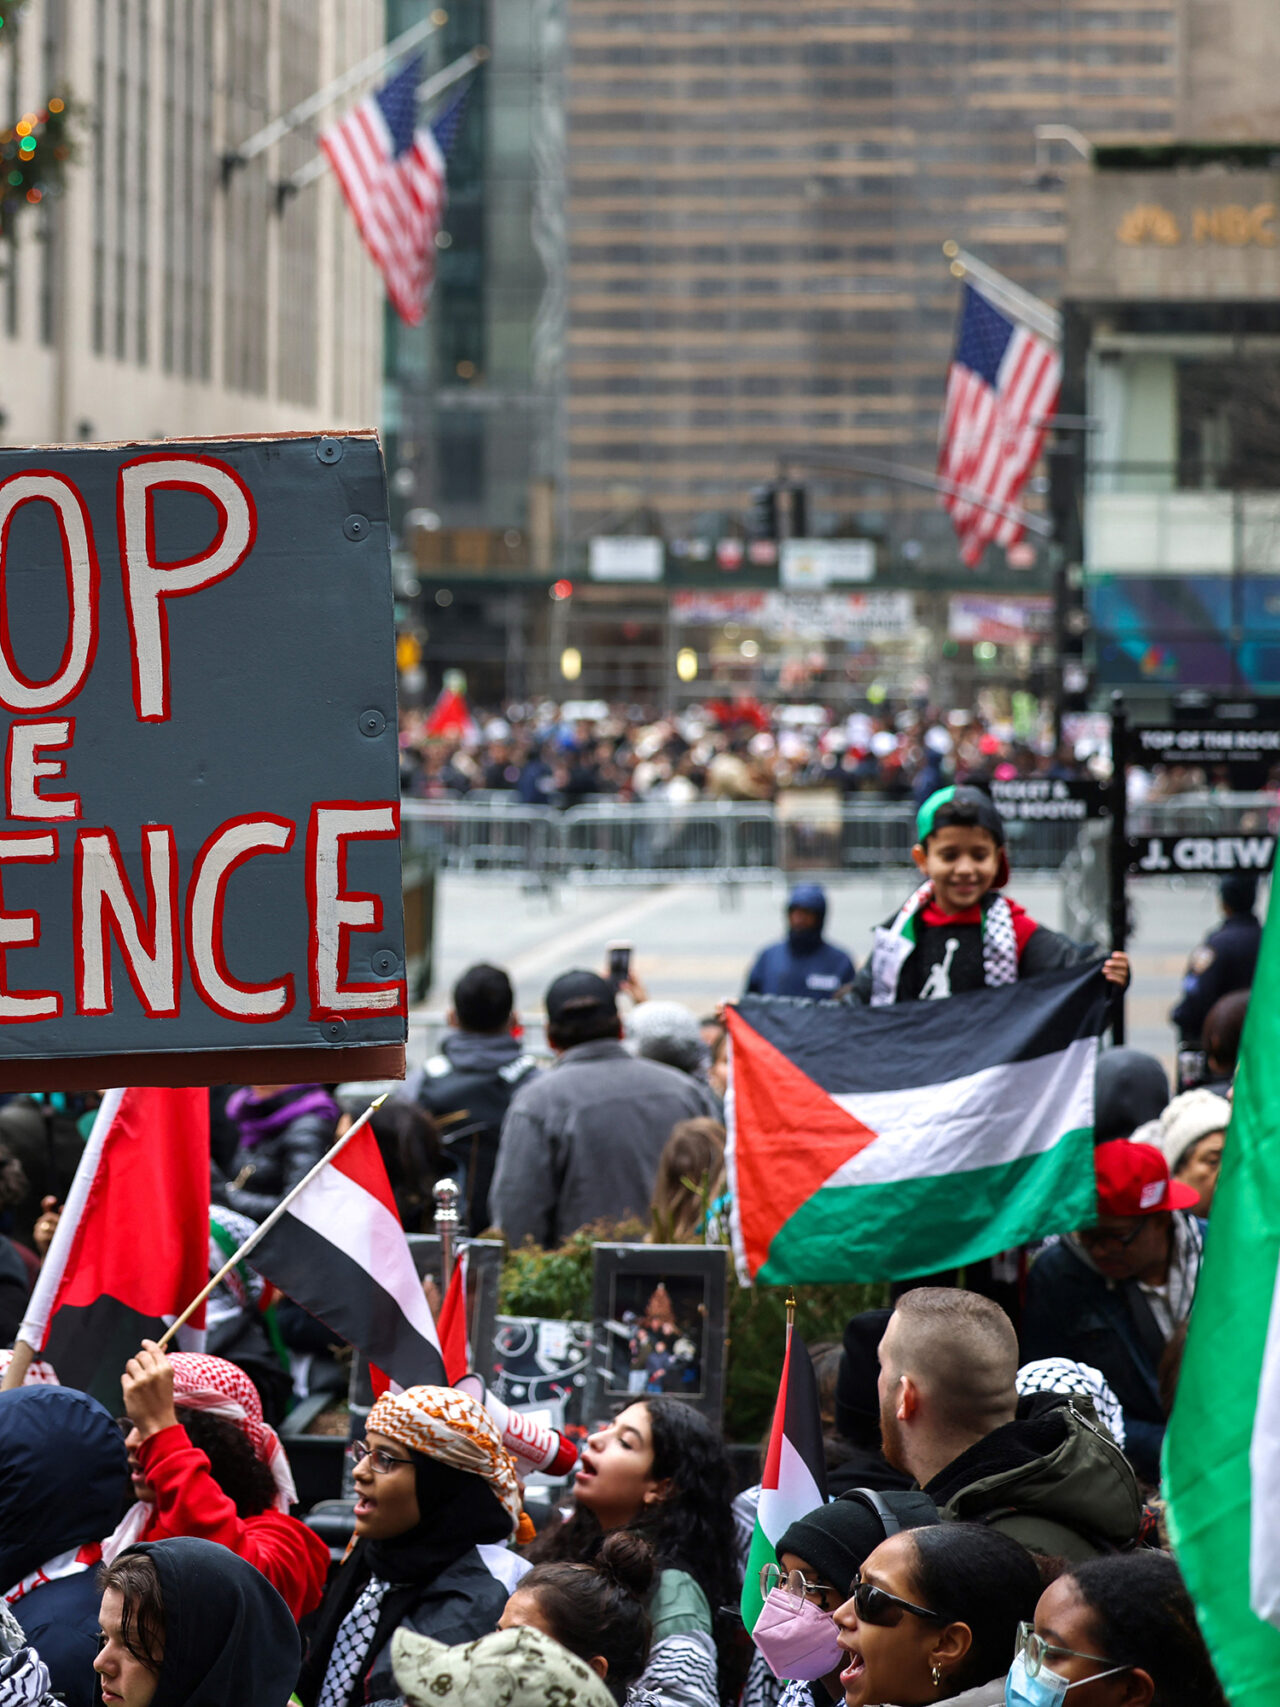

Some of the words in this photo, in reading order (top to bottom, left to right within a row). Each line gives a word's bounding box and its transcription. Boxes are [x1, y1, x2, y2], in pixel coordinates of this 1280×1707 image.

[1140, 730, 1174, 750] TOP
[1176, 730, 1200, 750] OF
[1201, 730, 1233, 750] THE
[1140, 838, 1171, 870] J.
[1173, 837, 1274, 870] CREW
